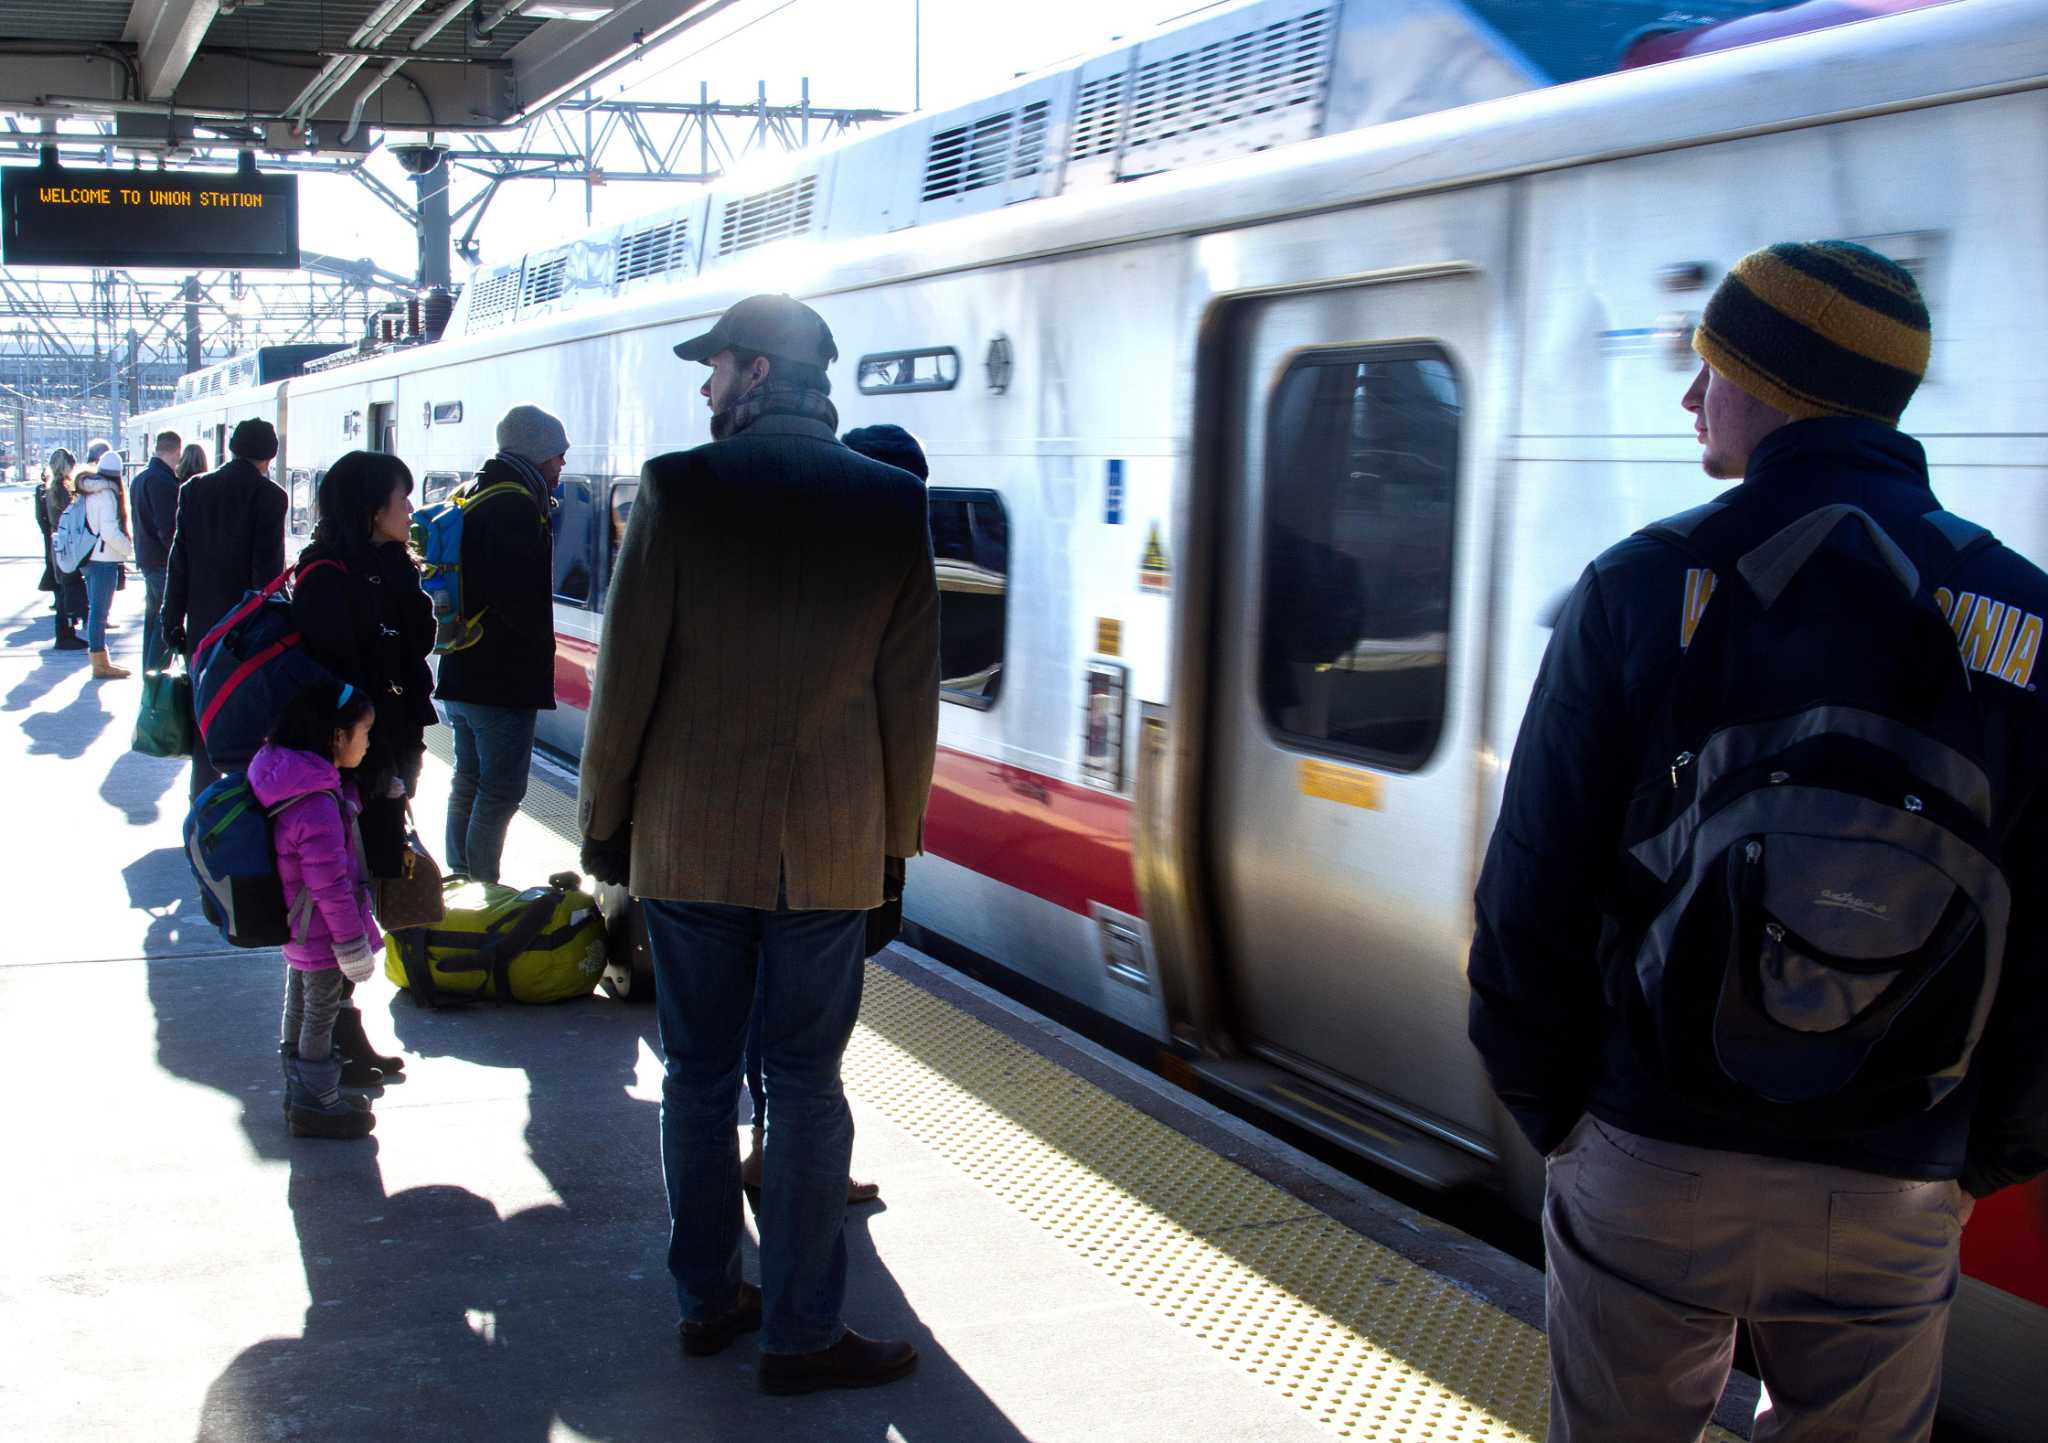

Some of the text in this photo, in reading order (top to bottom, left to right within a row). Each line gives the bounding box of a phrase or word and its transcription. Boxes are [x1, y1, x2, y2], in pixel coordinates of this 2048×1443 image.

[39, 187, 263, 208] WELCOME TO UNION STATION
